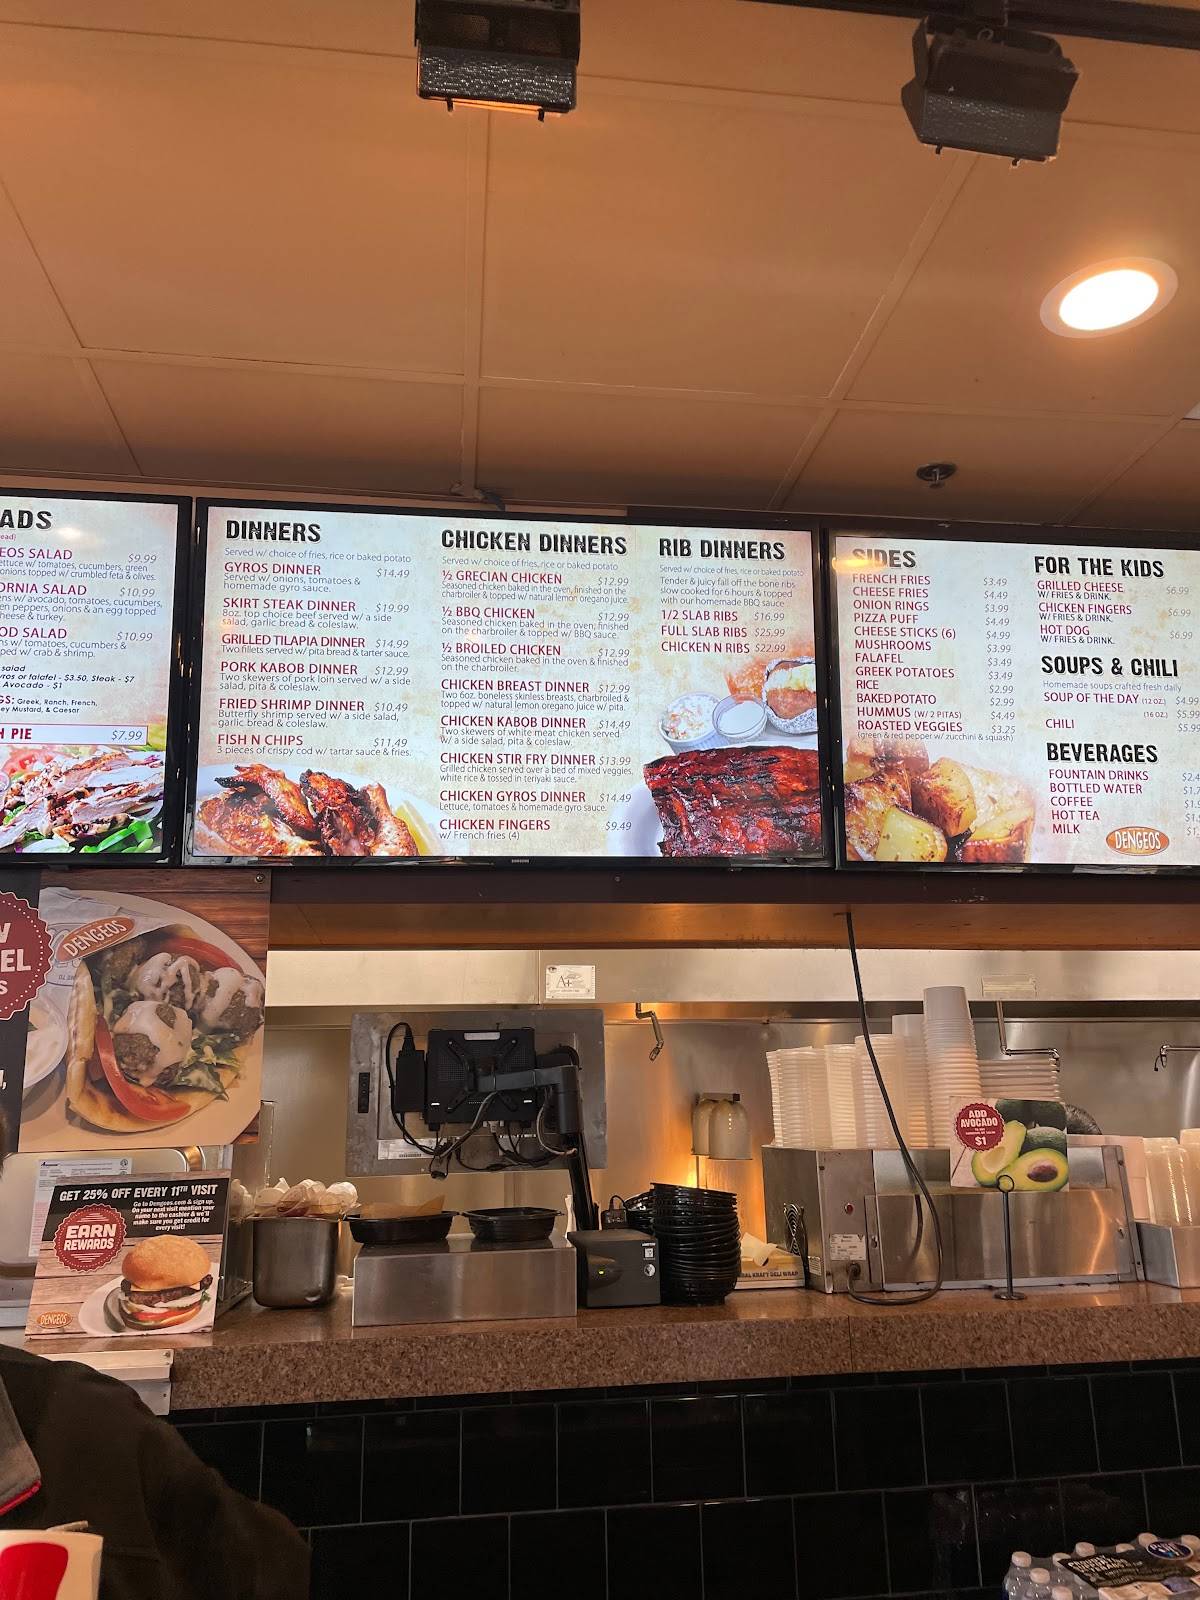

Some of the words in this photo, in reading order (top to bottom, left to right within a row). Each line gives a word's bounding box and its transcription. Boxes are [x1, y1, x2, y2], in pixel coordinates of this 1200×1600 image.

[226, 520, 321, 542] DINNERS
[441, 529, 530, 551] CHICKEN
[539, 534, 627, 554] DINNERS
[660, 538, 691, 557] RIB
[701, 540, 785, 559] DINNERS
[29, 549, 72, 560] SALAD
[128, 554, 157, 563] $9.99
[224, 548, 253, 557] Served
[269, 549, 297, 558] choice
[298, 550, 307, 558] of
[308, 550, 327, 560] fries,
[357, 553, 381, 562] baked
[383, 554, 411, 563] potato
[853, 549, 916, 567] SIDES
[38, 562, 78, 570] tomatoes,
[79, 563, 123, 572] cucumbers,
[224, 562, 268, 574] GYROS
[272, 564, 321, 575] DINNER
[1034, 556, 1070, 574] FOR
[1078, 557, 1113, 575] THE
[1121, 559, 1164, 577] KIDS
[376, 569, 409, 578] $14.49
[456, 571, 508, 582] GRECIAN
[511, 573, 562, 584] CHICKEN
[598, 578, 629, 586] $12.99
[853, 574, 897, 584] FRENCH
[901, 575, 930, 585] FRIES
[983, 577, 1007, 586] $3.49
[43, 584, 87, 595] SALAD
[1037, 580, 1081, 591] GRILLED
[1084, 582, 1124, 592] CHEESE
[120, 588, 155, 597] $10.99
[223, 598, 260, 608] SKIRT
[263, 599, 304, 610] STEAK
[307, 601, 356, 612] DINNER
[376, 604, 409, 614] $19.99
[853, 600, 891, 610] ONION
[895, 601, 929, 611] RINGS
[456, 607, 480, 617] BBQ
[484, 608, 535, 619] CHICKEN
[662, 610, 679, 619] 1/2
[682, 611, 710, 620] SLAB
[714, 611, 738, 621] RIBS
[754, 612, 785, 621] $16.99
[854, 613, 886, 623] PIZZA
[891, 614, 919, 624] PUFF
[661, 625, 688, 635] FULL
[692, 626, 720, 636] SLAB
[723, 627, 747, 637] RIBS
[755, 628, 785, 637] $25.99
[854, 627, 896, 636] CHEESE
[900, 628, 938, 637] STICKS
[942, 628, 956, 640] (6)
[986, 631, 1010, 640] $4.99
[1040, 625, 1062, 634] HOT
[1066, 626, 1089, 635] DOG
[222, 634, 271, 645] GRILLED
[275, 635, 317, 647] TILAPIA
[321, 637, 365, 648] DINNER
[375, 639, 409, 649] $14.99
[855, 640, 931, 650] MUSHROOMS
[855, 653, 903, 663] FALAFEL
[1042, 656, 1103, 674] SOUPS
[1111, 658, 1123, 675] &
[1131, 658, 1178, 677] CHILI
[856, 667, 892, 677] GREEK
[895, 668, 954, 678] POTATOES
[53, 682, 62, 690] $1
[441, 679, 493, 691] CHICKEN
[497, 681, 542, 691] BREAST
[545, 682, 589, 693] DINNER
[599, 684, 630, 693] $12.99
[856, 680, 879, 690] RICE
[857, 693, 892, 703] BAKED
[895, 694, 936, 704] POTATO
[1044, 692, 1073, 702] SOUP
[1077, 693, 1090, 703] OF
[1093, 694, 1114, 703] THE
[1117, 694, 1139, 704] DAY
[219, 698, 257, 710] FRIED
[260, 699, 311, 711] SHRIMP
[315, 700, 364, 711] DINNER
[374, 703, 408, 712] $10.49
[858, 707, 911, 717] HUMMUS
[858, 720, 911, 731] ROASTED
[915, 721, 963, 732] VEGGIES
[1046, 719, 1075, 728] CHILI
[11, 728, 32, 739] PIE
[992, 725, 1016, 734] $3.25
[111, 730, 143, 741] $7.99
[218, 734, 247, 745] FISH
[251, 735, 260, 745] N
[265, 735, 303, 746] CHIPS
[373, 738, 407, 748] $11.49
[1047, 742, 1158, 763] BEVERAGES
[440, 753, 493, 764] CHICKEN
[496, 753, 522, 764] STIR
[526, 754, 547, 765] FRY
[551, 755, 596, 765] DINNER
[599, 756, 631, 766] $13.99
[1049, 769, 1106, 779] FOUNTAIN
[1109, 771, 1148, 780] DRINKS
[1050, 783, 1100, 793] BOTTLED
[1104, 784, 1143, 794] WATER
[1051, 797, 1093, 806] COFFEE
[440, 819, 494, 830] CHICKEN
[498, 820, 550, 830] FINGERS
[605, 822, 631, 831] $9.49
[1053, 824, 1080, 833] MILK
[453, 831, 484, 839] French
[487, 831, 505, 839] fries
[508, 831, 520, 840] (4)
[1115, 831, 1160, 849] DENGEOS
[63, 920, 127, 956] DENGEOS
[969, 1110, 987, 1118] ADD
[961, 1118, 998, 1128] AVOCADO
[976, 1137, 987, 1145] $1
[60, 1191, 80, 1201] GET
[83, 1189, 108, 1200] 25%
[111, 1188, 131, 1198] OFF
[134, 1187, 168, 1197] EVERY
[191, 1185, 218, 1195] VISIT
[66, 1224, 116, 1238] EARN
[64, 1238, 114, 1250] REWARDS
